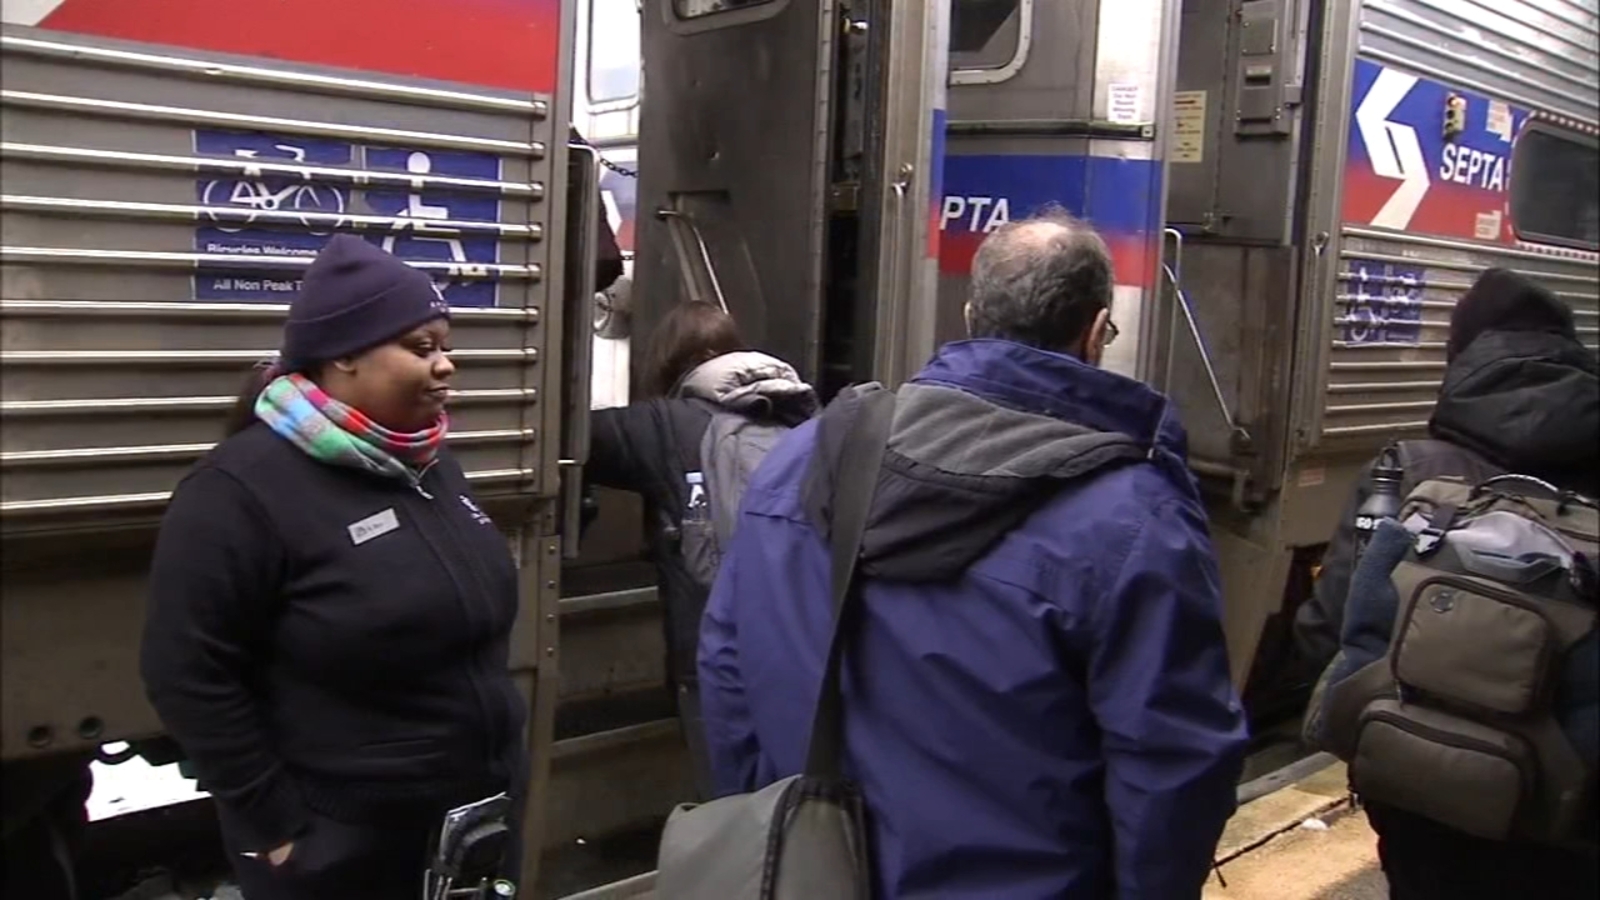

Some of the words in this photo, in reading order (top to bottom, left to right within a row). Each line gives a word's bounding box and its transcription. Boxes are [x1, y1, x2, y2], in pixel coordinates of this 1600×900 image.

[1440, 143, 1504, 192] SEPTA
[213, 279, 232, 290] All
[234, 280, 260, 291] Non
[263, 280, 294, 291] Peak
